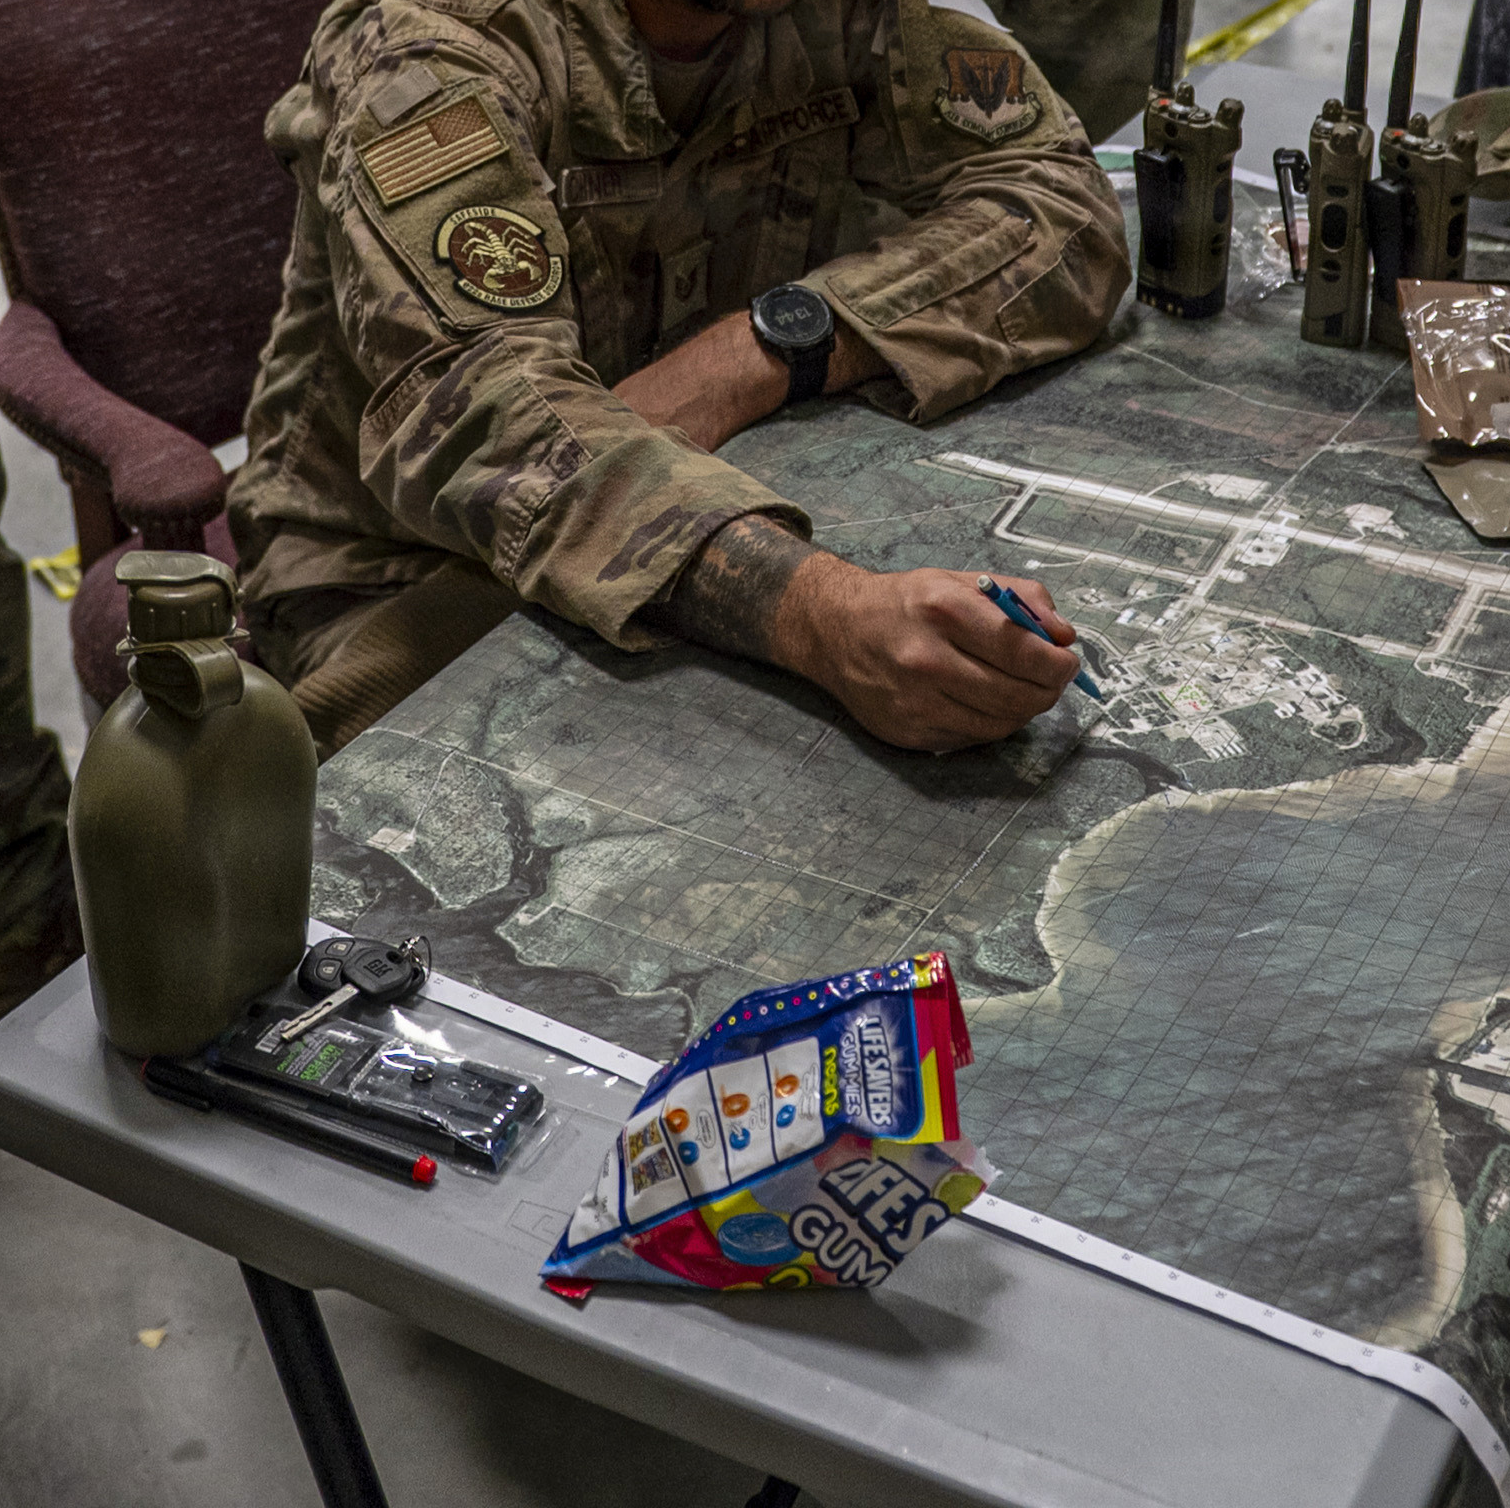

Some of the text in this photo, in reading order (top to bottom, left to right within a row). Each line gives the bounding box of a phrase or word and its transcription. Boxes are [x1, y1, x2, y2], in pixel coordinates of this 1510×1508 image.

[780, 93, 848, 135] FORCE
[450, 207, 497, 225] SAFESIDE
[366, 958, 394, 978] GM
[840, 1032, 863, 1117] GUMMIES
